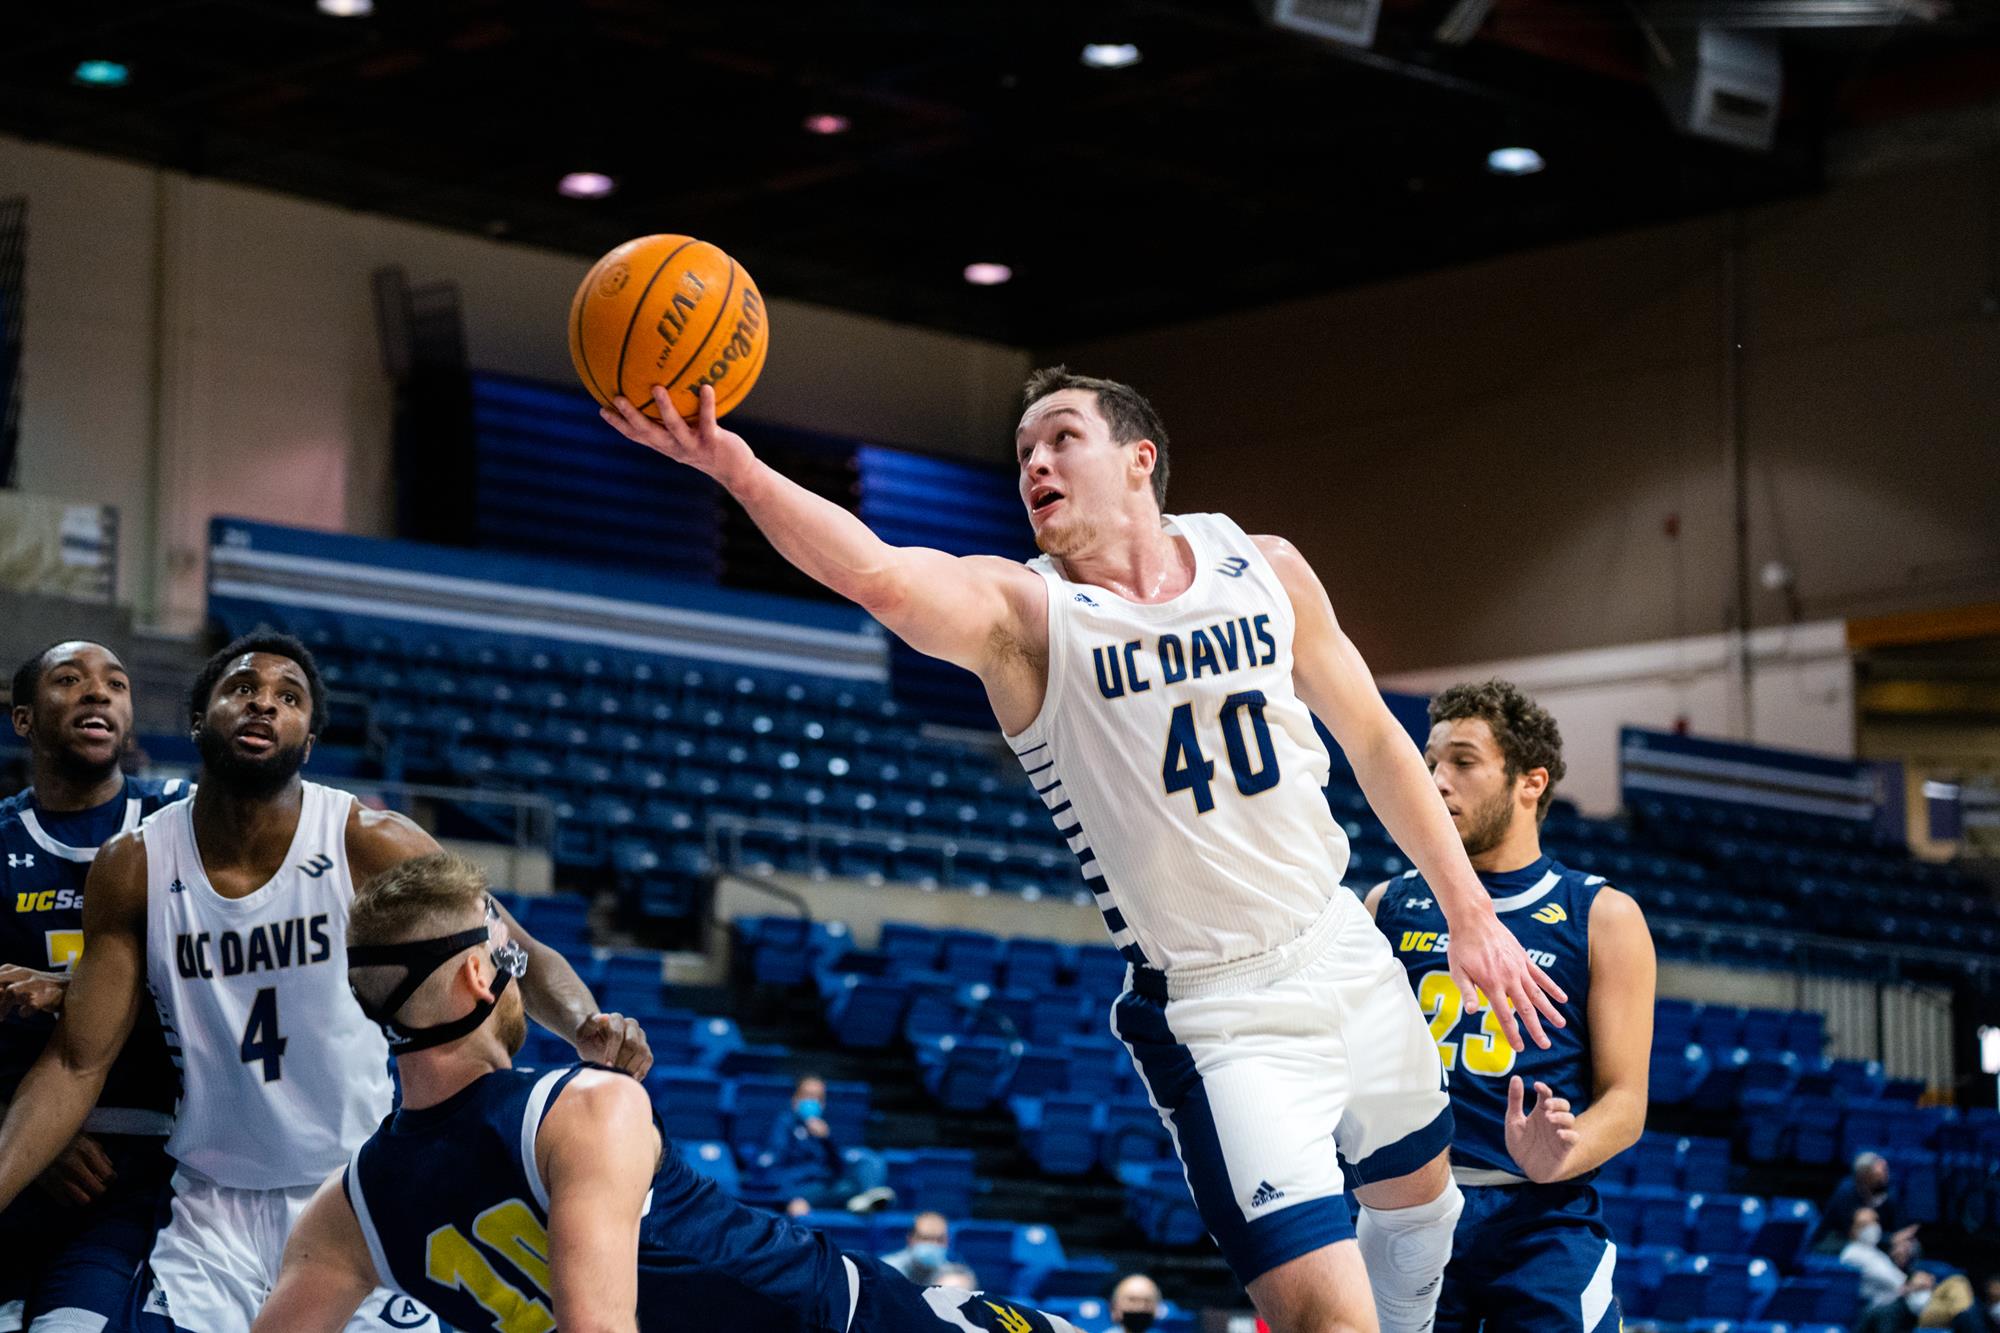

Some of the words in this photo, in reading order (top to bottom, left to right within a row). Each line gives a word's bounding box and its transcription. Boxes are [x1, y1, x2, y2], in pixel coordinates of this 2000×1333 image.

[1092, 640, 1151, 700] UC
[1157, 613, 1277, 686] DAVIS
[1161, 689, 1281, 816] 40
[15, 889, 84, 913] UCSa
[1399, 931, 1450, 953] UCS
[175, 931, 214, 980] UC
[219, 913, 331, 977] DAVIS
[240, 985, 288, 1085] 4
[1417, 970, 1520, 1078] 23
